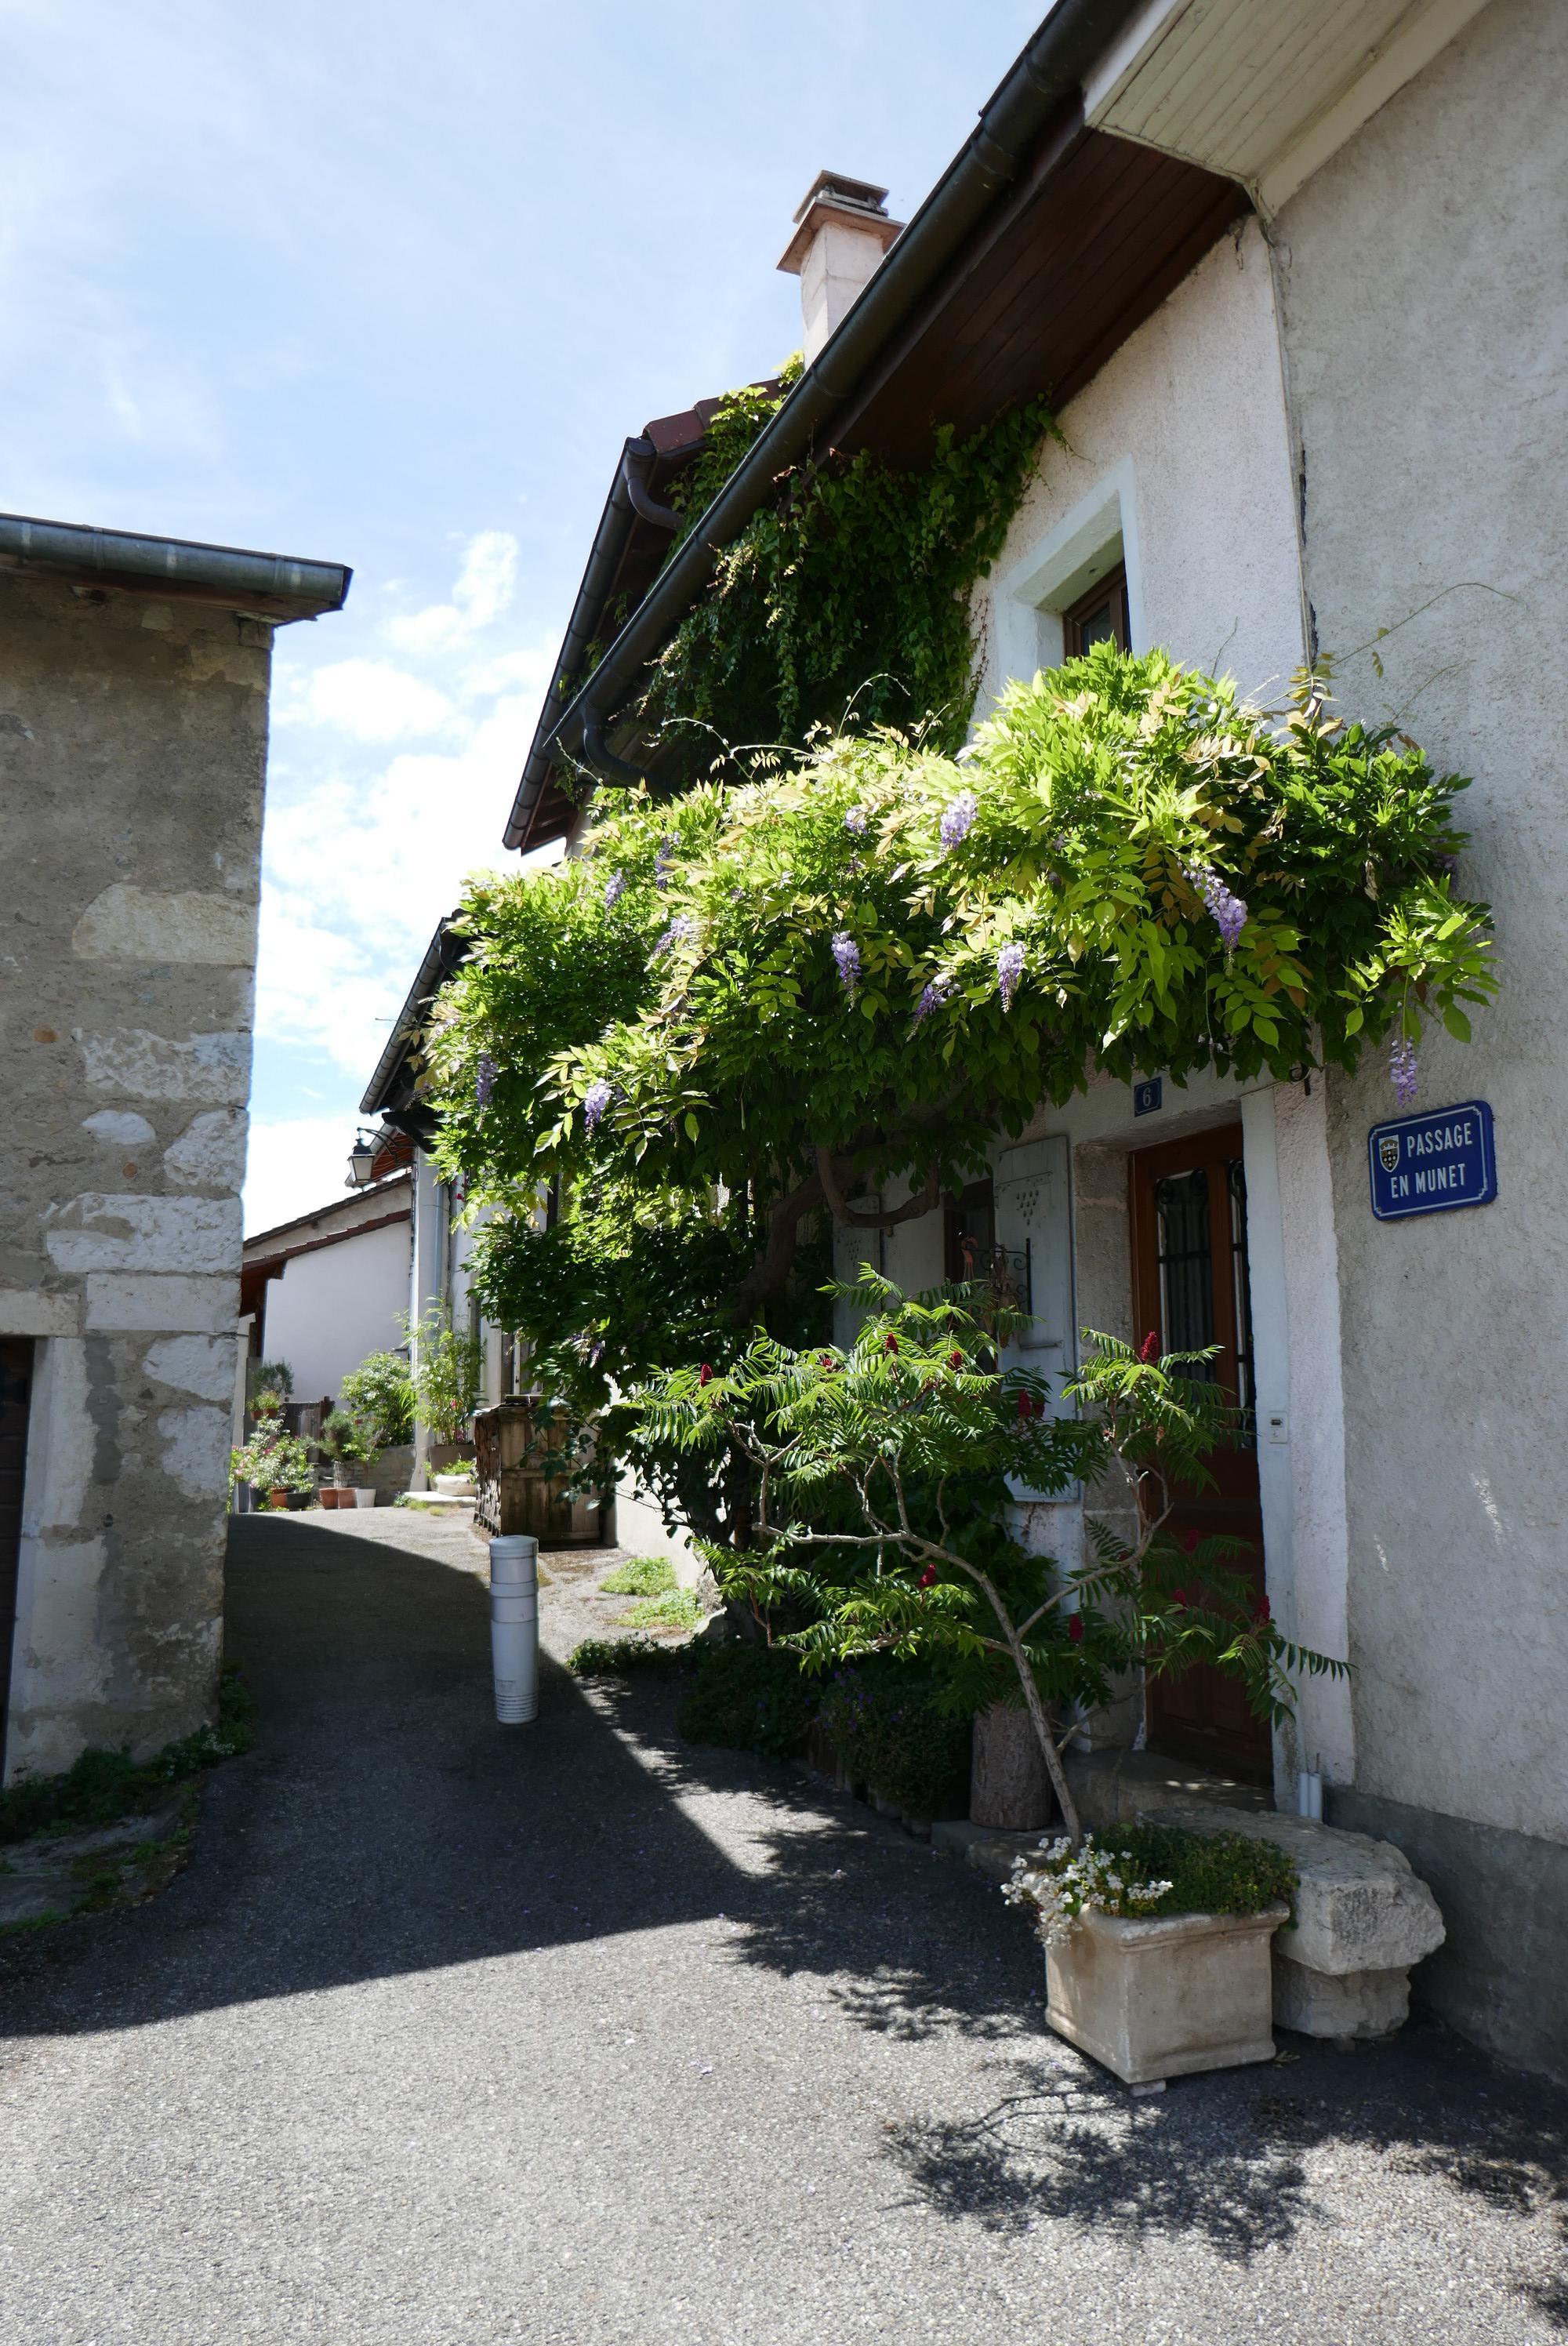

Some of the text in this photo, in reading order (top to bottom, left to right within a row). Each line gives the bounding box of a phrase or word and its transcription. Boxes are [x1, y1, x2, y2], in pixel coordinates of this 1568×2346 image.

[1142, 1087, 1152, 1107] 6
[1406, 1122, 1473, 1158] PASSAGE
[1391, 1163, 1466, 1199] EN MUNET
